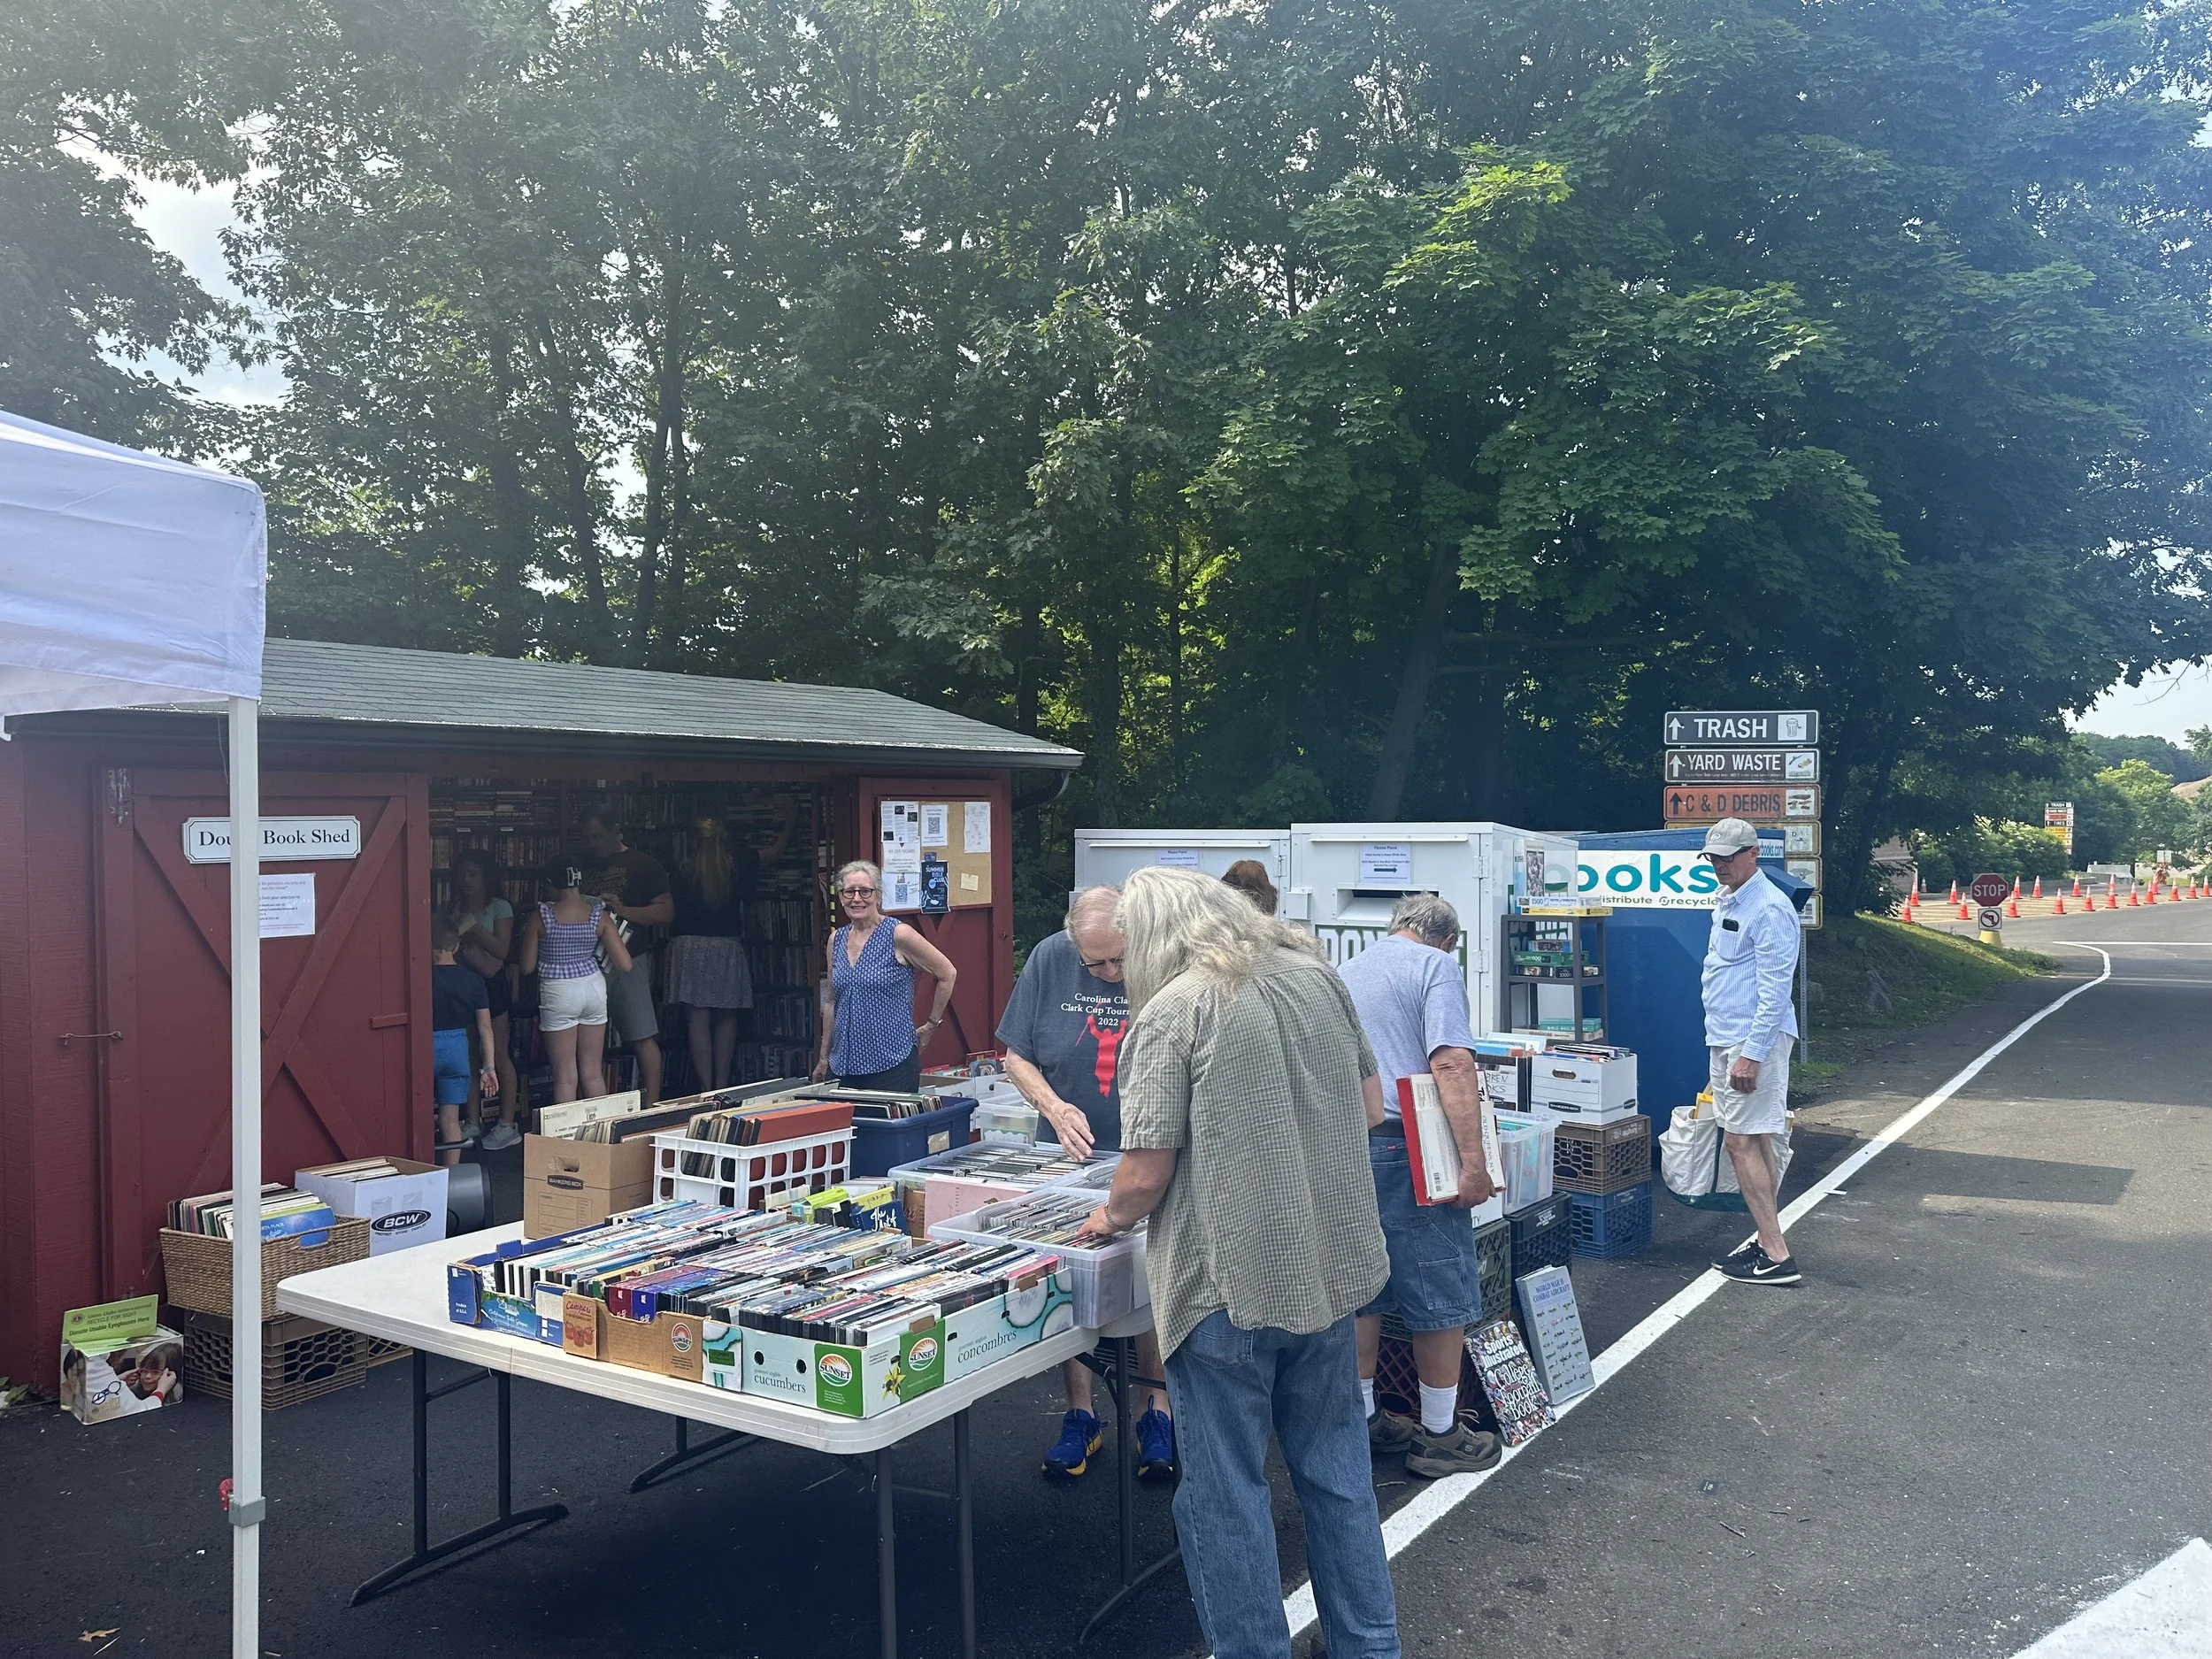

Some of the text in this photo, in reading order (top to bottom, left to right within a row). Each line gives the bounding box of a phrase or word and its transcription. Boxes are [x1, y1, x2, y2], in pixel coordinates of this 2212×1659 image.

[1694, 718, 1767, 739] TRASH
[1686, 754, 1781, 771] YARD WASTE
[1686, 793, 1781, 812] C & D DEBRIS
[263, 829, 306, 845] Book
[311, 828, 350, 844] Shed
[1578, 853, 1719, 895] ooks
[1973, 884, 2006, 897] STOP
[1601, 895, 1653, 905] istribute
[1074, 993, 1111, 1003] Carolina
[1060, 1002, 1084, 1012] Clark
[1085, 1005, 1104, 1016] Cup
[1097, 1017, 1118, 1026] 2022
[549, 1177, 572, 1186] BANKERS
[383, 1213, 420, 1229] BCW
[870, 1206, 887, 1233] The
[565, 1300, 592, 1316] Campari
[107, 1318, 137, 1329] Eyeglasses
[672, 1336, 692, 1346] SUNSET
[957, 1329, 1018, 1363] concombres
[1484, 1333, 1514, 1356] Sports
[910, 1348, 937, 1363] SUNSET
[1482, 1341, 1526, 1370] Illustrated
[819, 1363, 853, 1380] SUNSET
[1494, 1363, 1532, 1390] College
[754, 1373, 807, 1394] cucumbers
[1501, 1375, 1541, 1407] Football
[1509, 1396, 1540, 1420] Book
